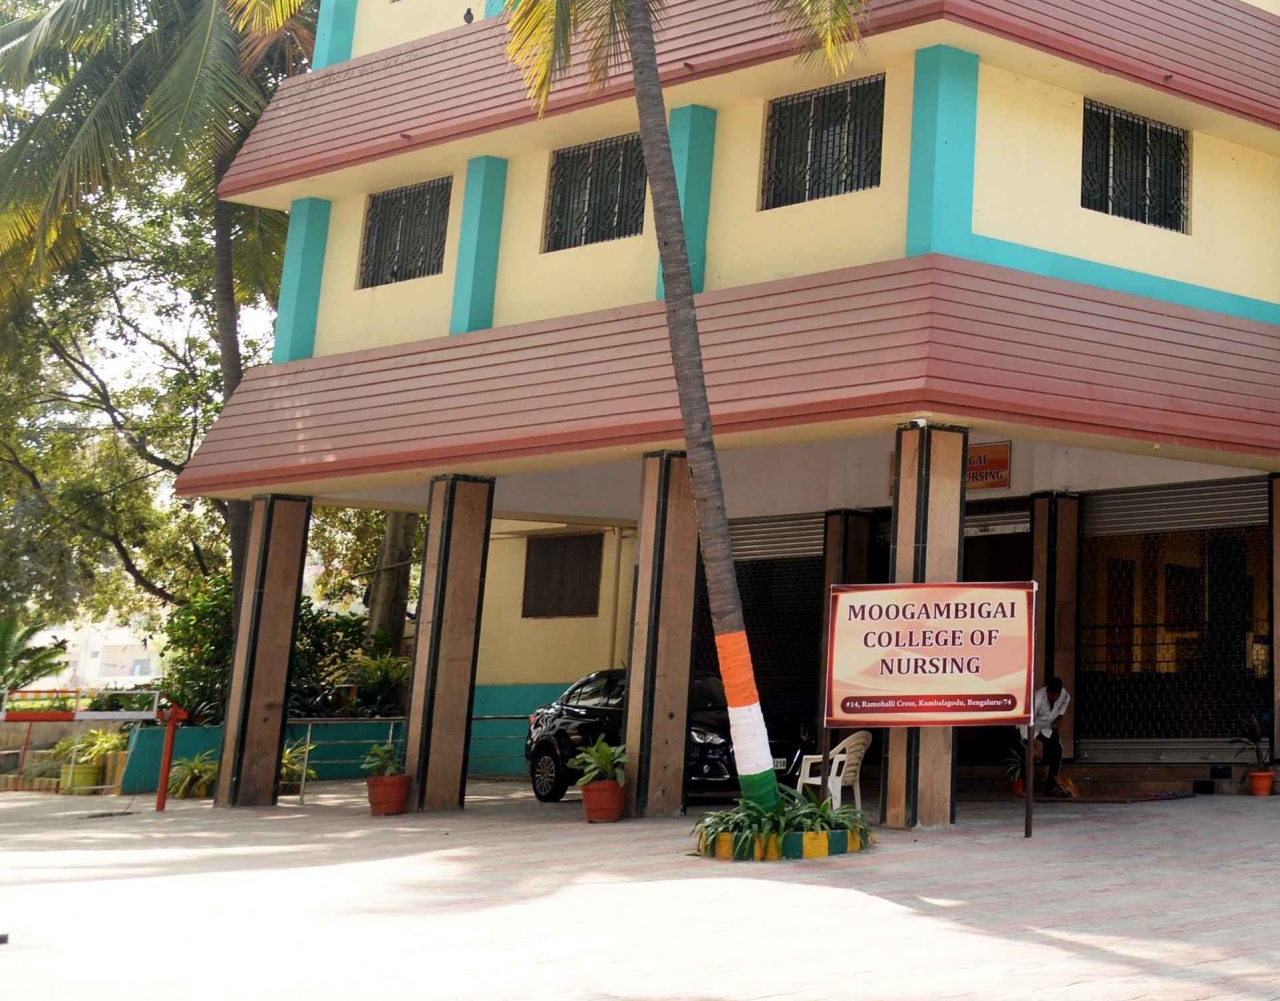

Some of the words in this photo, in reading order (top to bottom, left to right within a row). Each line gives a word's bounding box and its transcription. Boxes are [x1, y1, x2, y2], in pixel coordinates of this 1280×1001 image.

[967, 470, 1004, 482] RSING
[848, 602, 1016, 621] MOOGAMBIGAI
[863, 630, 963, 648] COLLEGE
[970, 629, 999, 646] OF
[880, 657, 980, 675] NURSING
[862, 700, 896, 708] Ramohalli
[896, 700, 917, 708] Cross,
[919, 699, 966, 708] Kumbalagodu,
[967, 698, 1012, 708] Bengaluru-74
